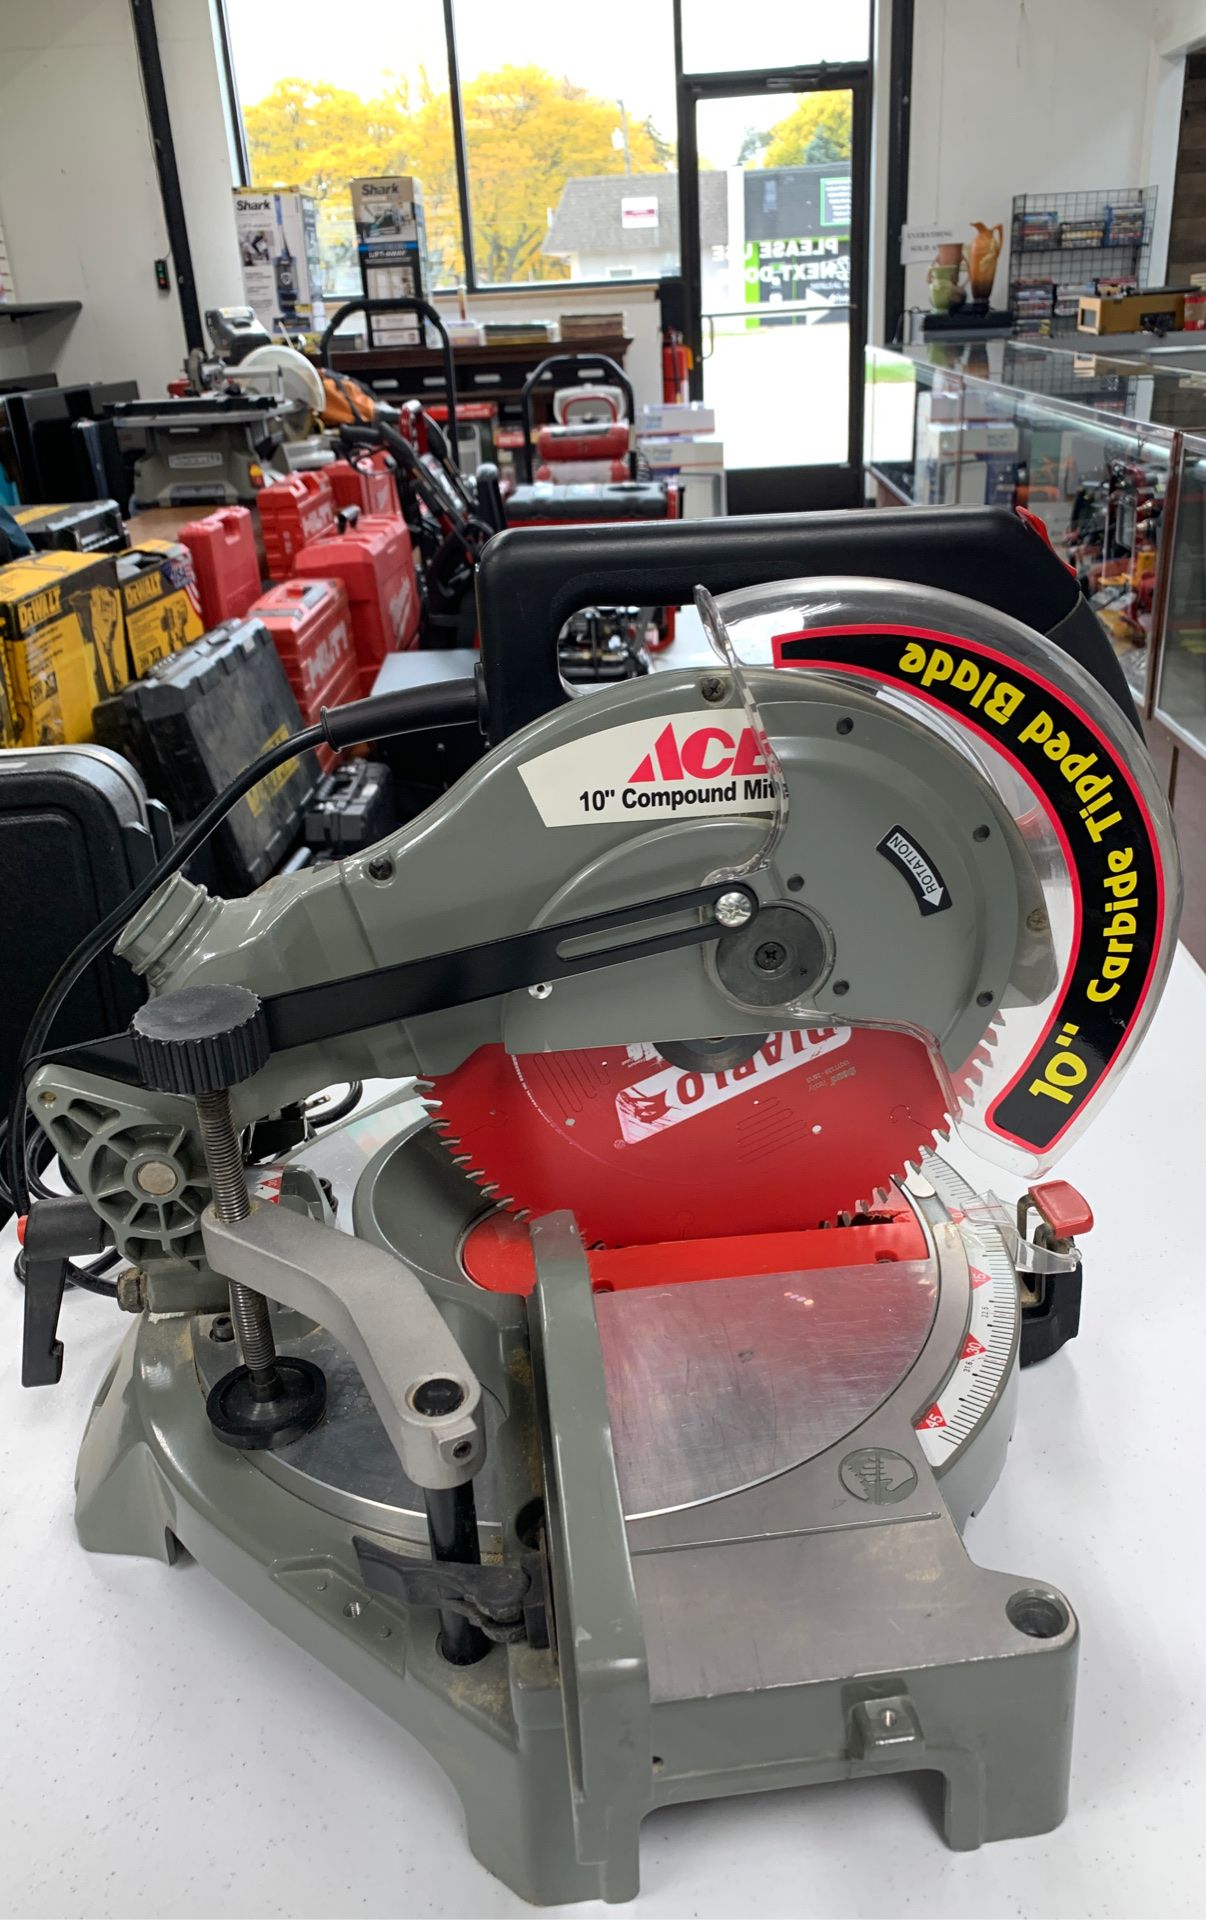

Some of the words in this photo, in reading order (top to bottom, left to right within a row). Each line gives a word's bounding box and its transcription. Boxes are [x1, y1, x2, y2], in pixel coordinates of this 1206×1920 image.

[237, 199, 271, 211] Shark
[362, 183, 399, 196] Shark
[21, 587, 61, 628] DEWALT
[899, 643, 1026, 725] Blade
[627, 722, 774, 783] ACE
[579, 790, 615, 811] 10"
[622, 781, 736, 811] Compound
[1018, 710, 1122, 843] Tipped
[888, 835, 938, 894] ROTATION
[1087, 847, 1138, 1002] Carbide
[966, 1342, 983, 1357] 30
[926, 1413, 943, 1429] 45
